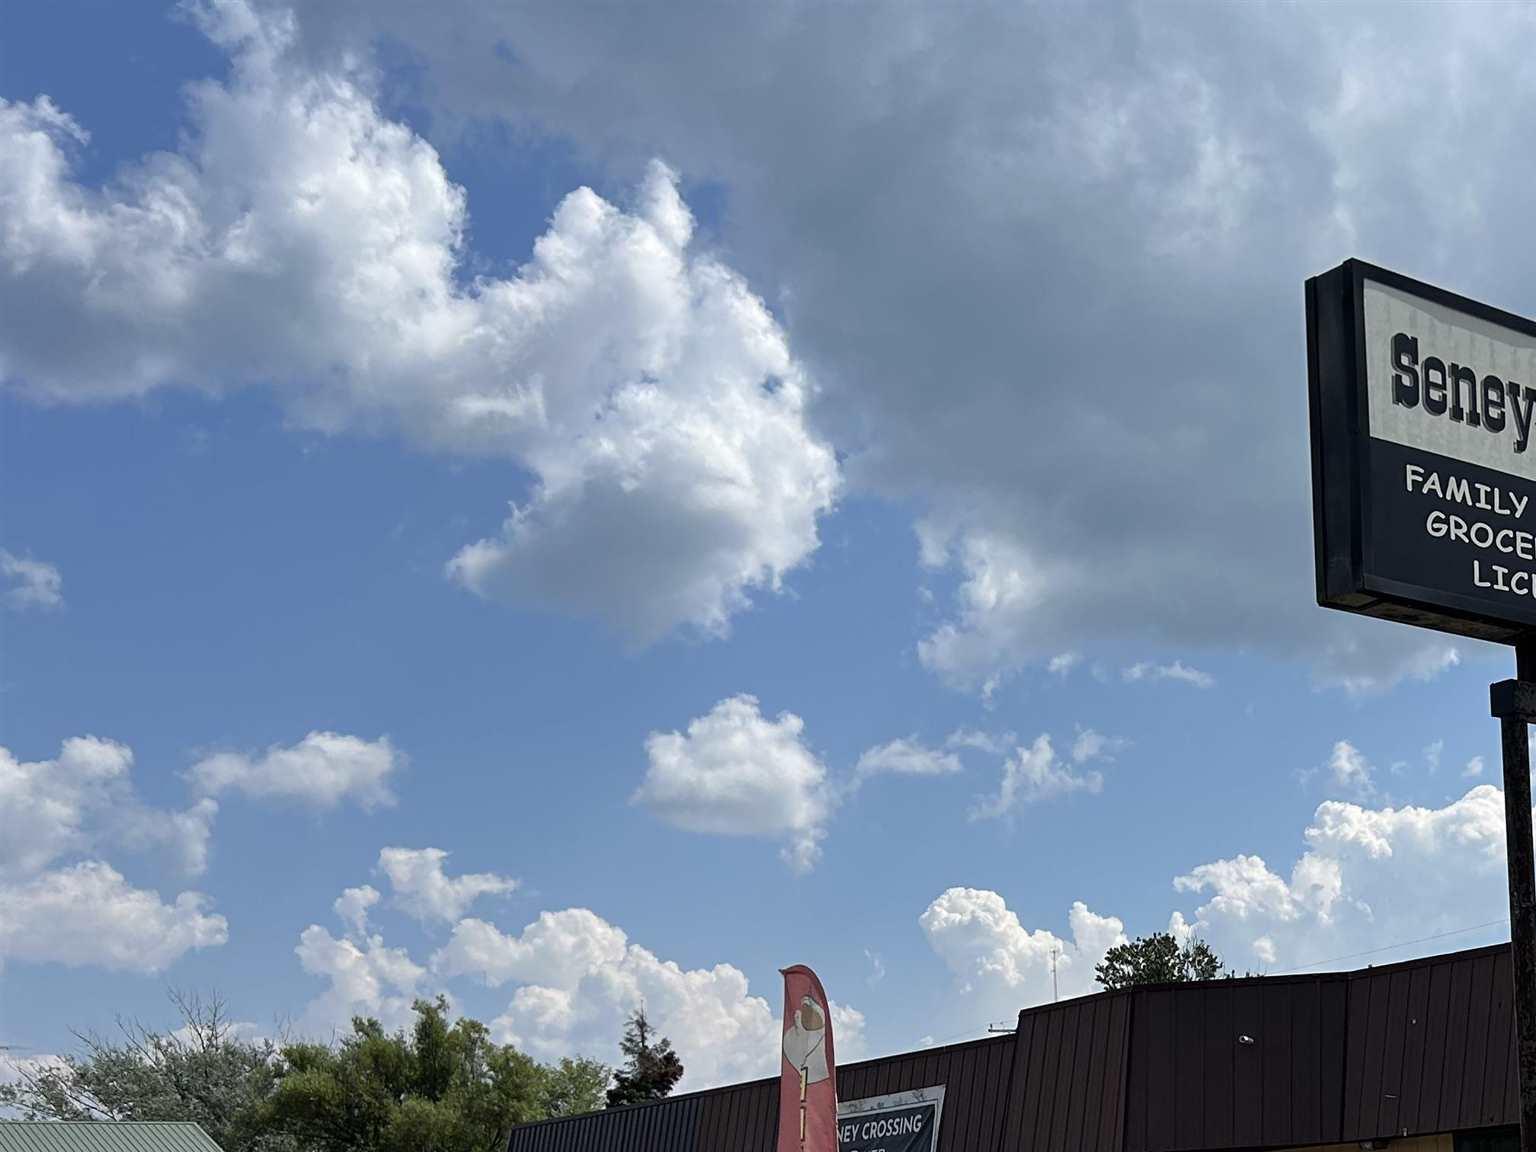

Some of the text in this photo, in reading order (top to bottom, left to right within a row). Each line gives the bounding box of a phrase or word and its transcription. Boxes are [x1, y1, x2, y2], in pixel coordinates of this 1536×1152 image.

[1390, 332, 1536, 453] Seney
[1405, 464, 1528, 519] FAMILY
[838, 1114, 922, 1143] NEY CROSSING
